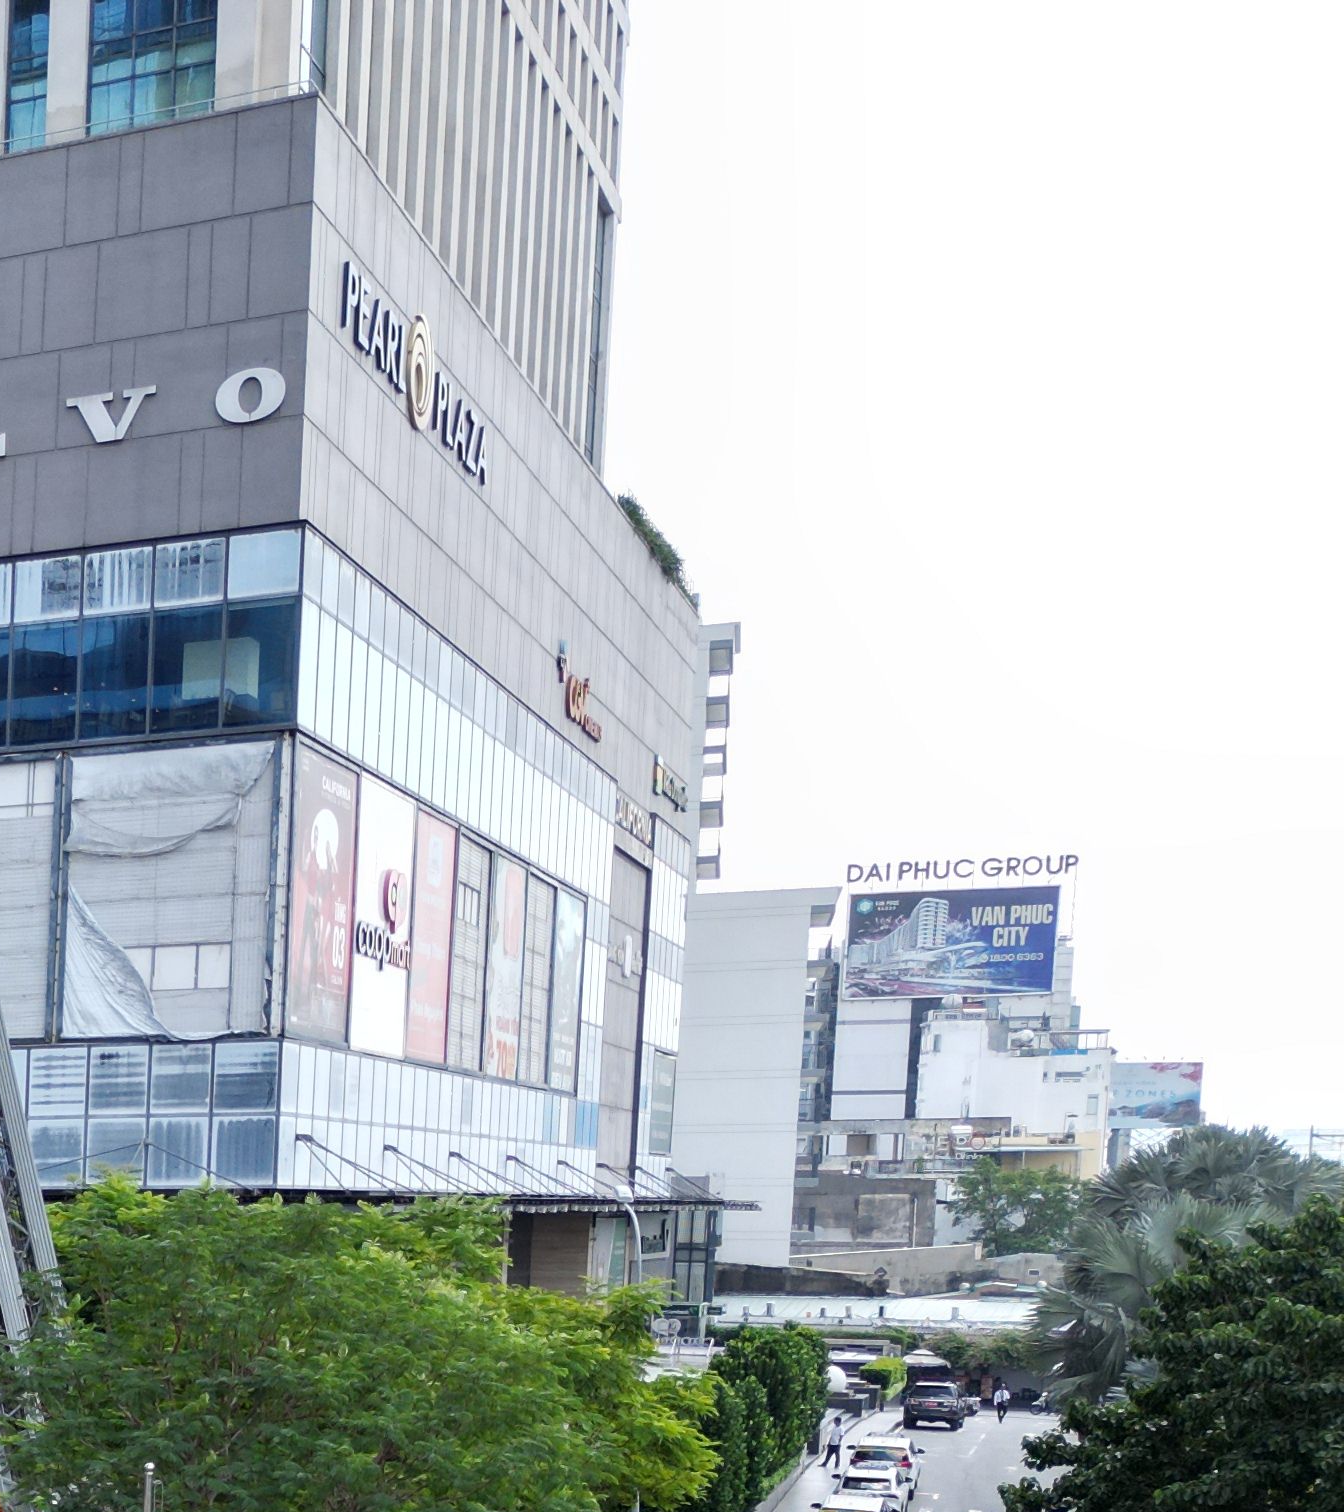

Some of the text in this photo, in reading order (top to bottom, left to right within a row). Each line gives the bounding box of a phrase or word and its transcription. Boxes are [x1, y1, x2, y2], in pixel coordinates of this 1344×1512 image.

[340, 260, 488, 486] PEARL PLAZA
[847, 854, 1079, 883] DAI PHUC GROUP
[971, 903, 1054, 926] VAN PHUC
[992, 926, 1030, 948] CITY
